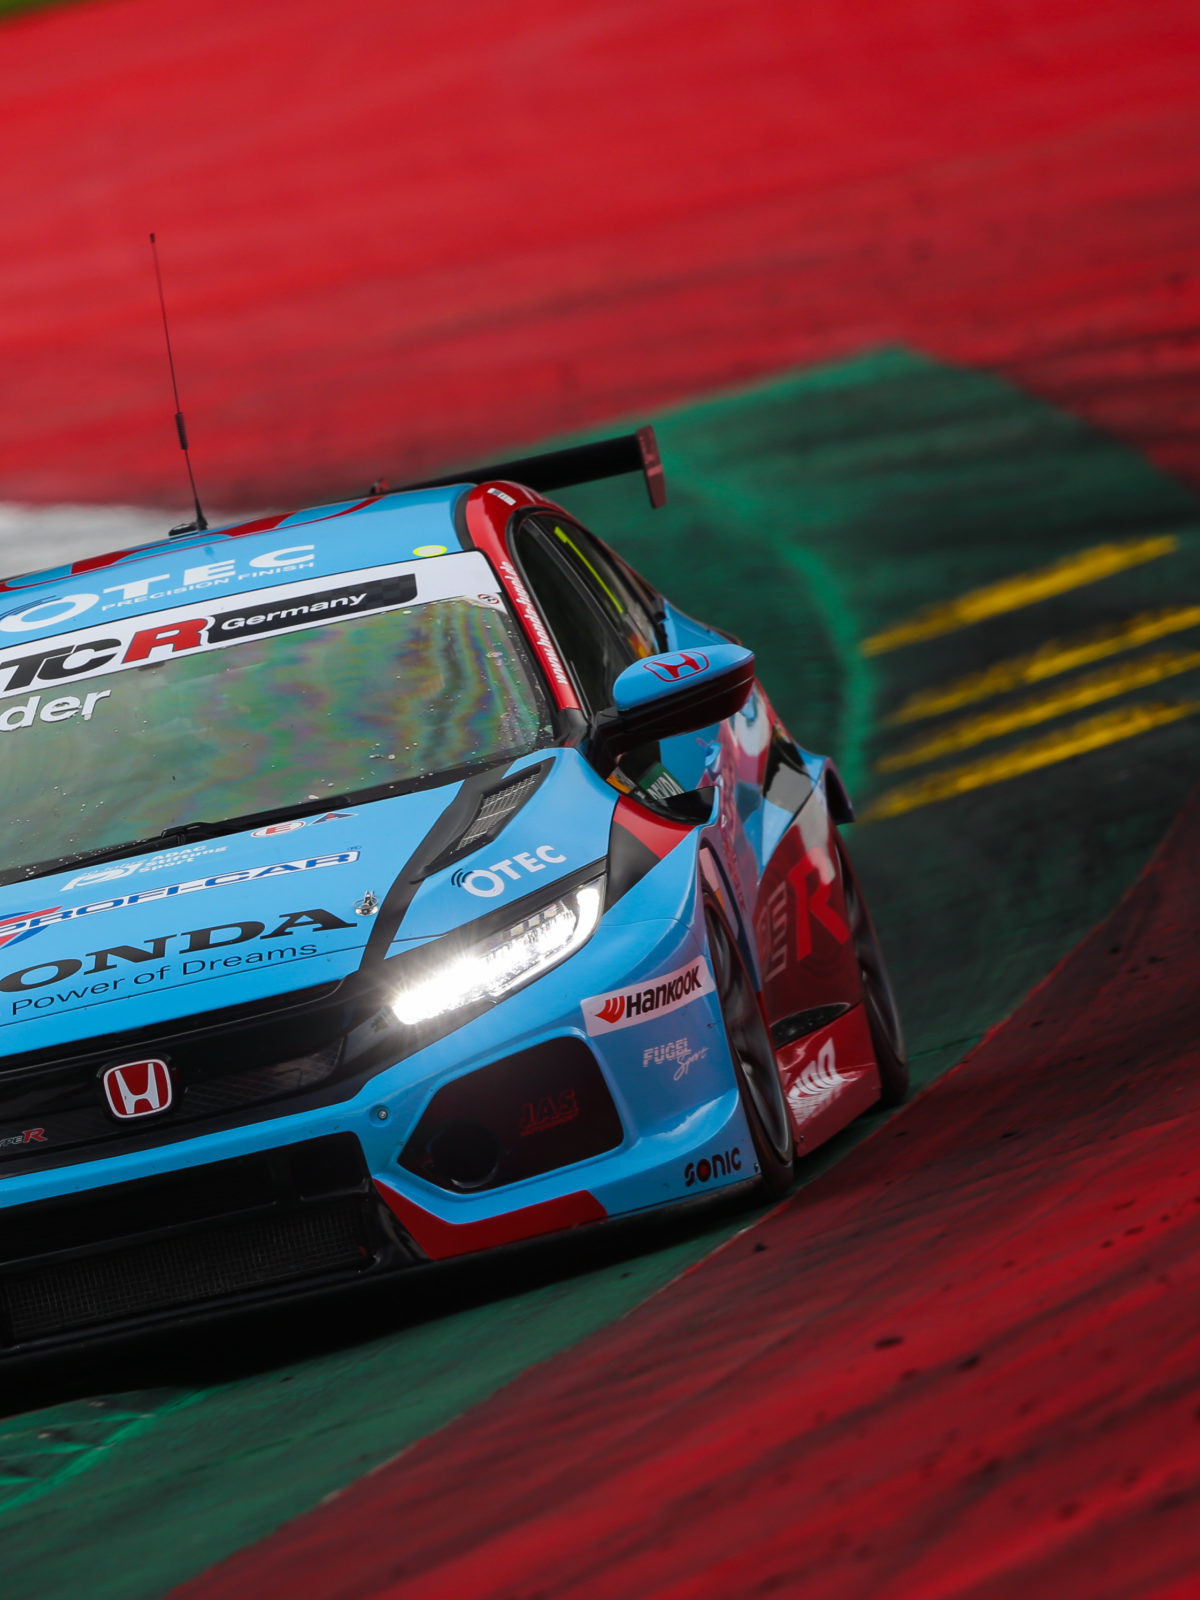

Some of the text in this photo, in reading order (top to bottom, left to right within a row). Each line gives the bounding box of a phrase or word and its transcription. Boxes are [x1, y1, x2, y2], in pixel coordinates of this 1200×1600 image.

[102, 562, 315, 612] PRECISION FINISH
[220, 591, 368, 632] Germany
[458, 845, 568, 898] OTEC
[11, 977, 126, 1016] Power
[133, 964, 173, 986] of
[182, 942, 317, 975] Dreams
